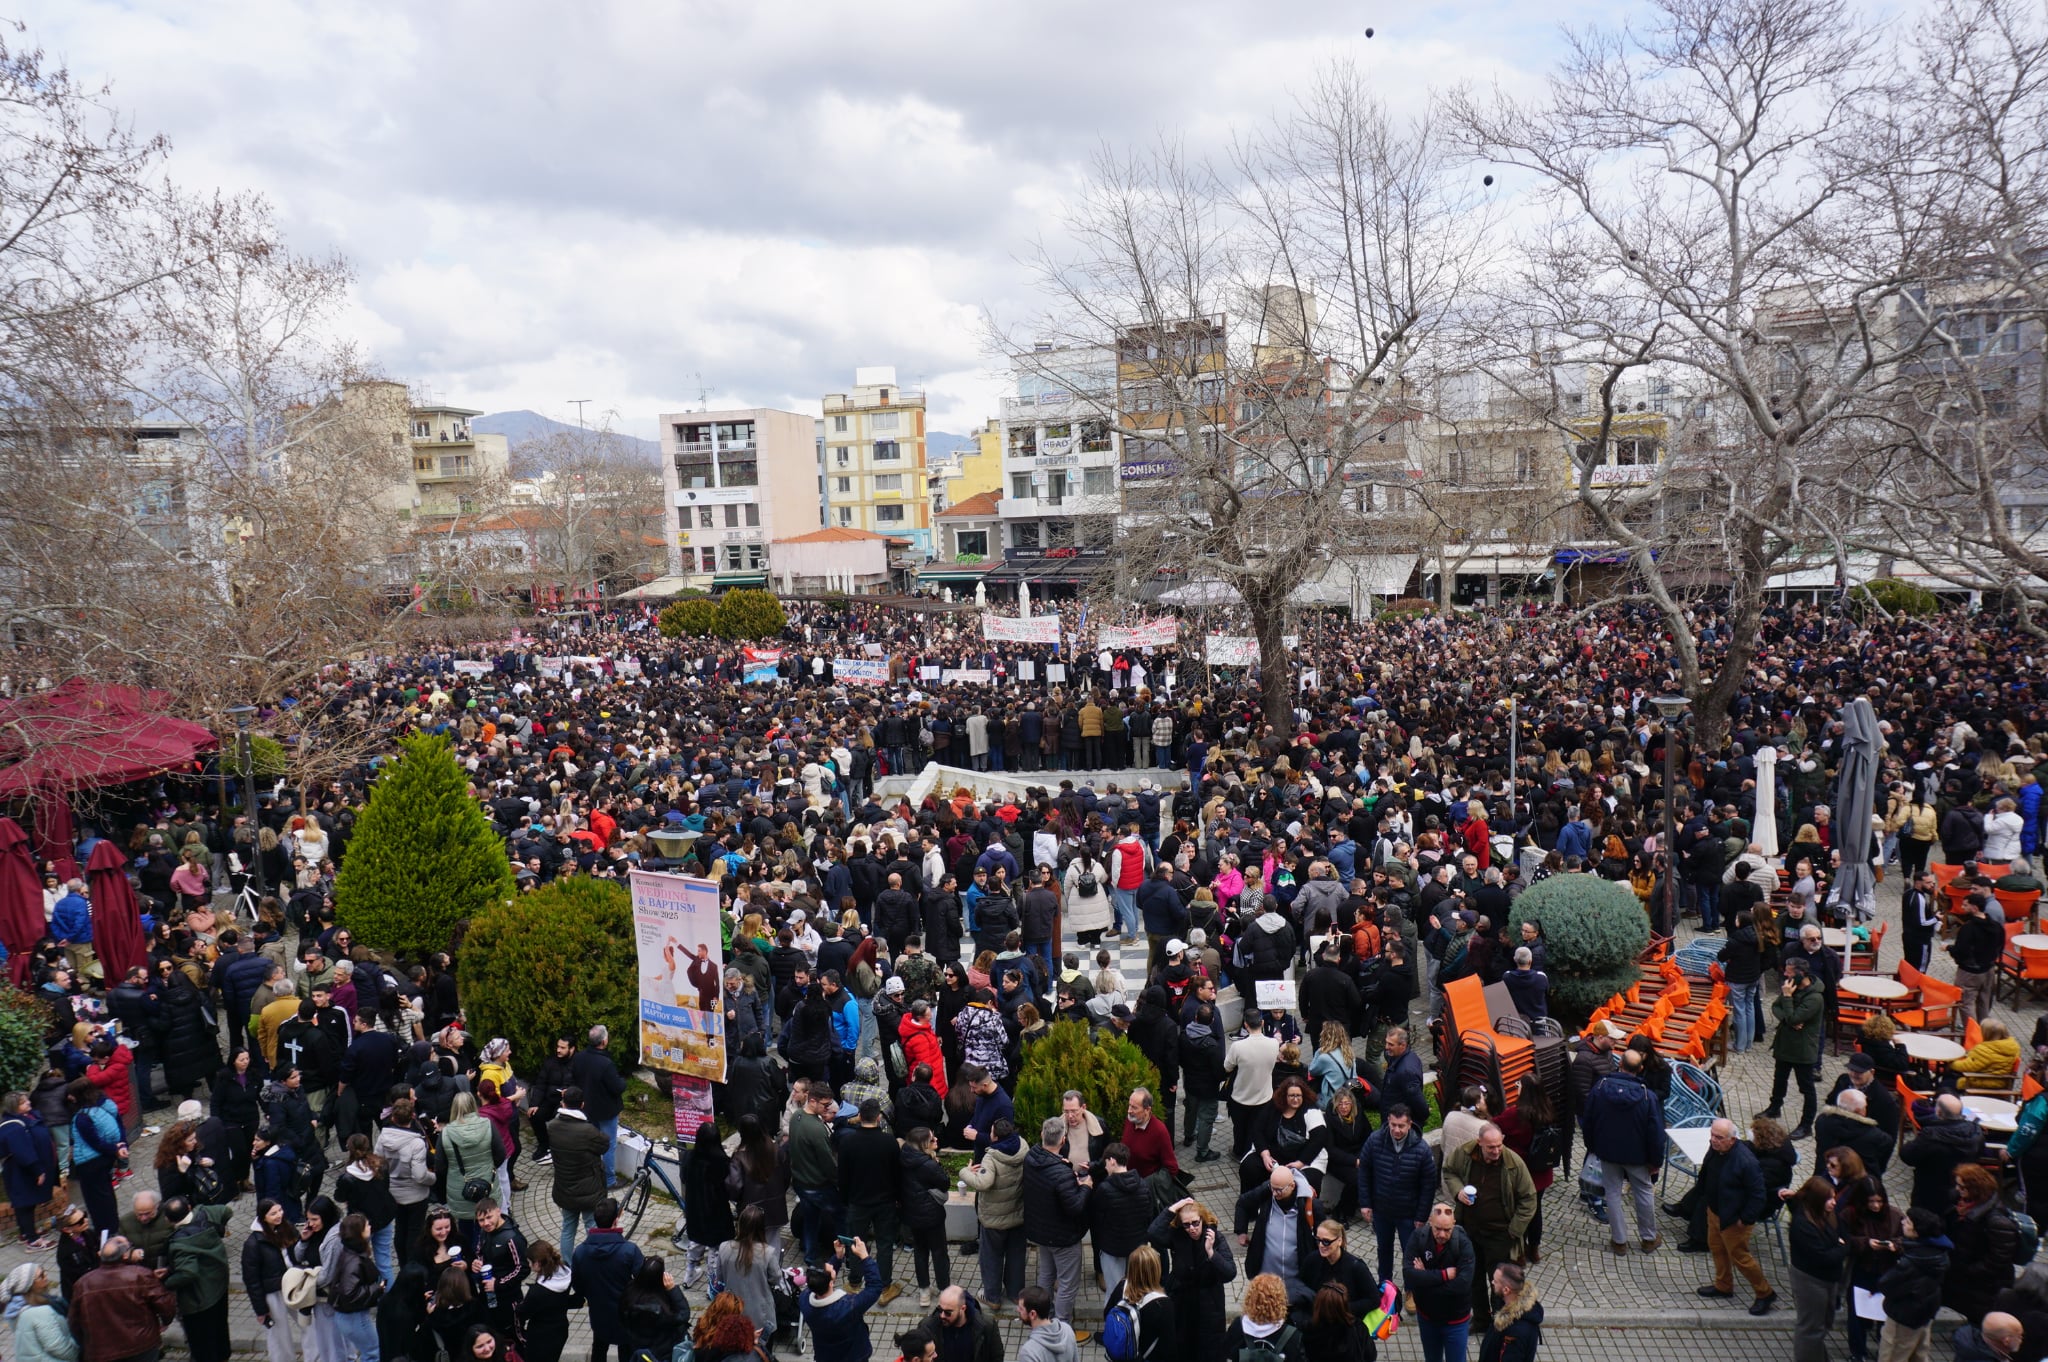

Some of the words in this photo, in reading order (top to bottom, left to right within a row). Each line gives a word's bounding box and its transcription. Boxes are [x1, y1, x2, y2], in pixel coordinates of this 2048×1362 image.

[1043, 440, 1068, 449] HEAD
[637, 885, 688, 902] WEDDING
[638, 896, 645, 905] &
[648, 897, 696, 913] BAPTISM
[638, 906, 659, 916] Show
[661, 911, 679, 920] 2025
[644, 1007, 671, 1020] ΜΑΡΤΙΟΥ
